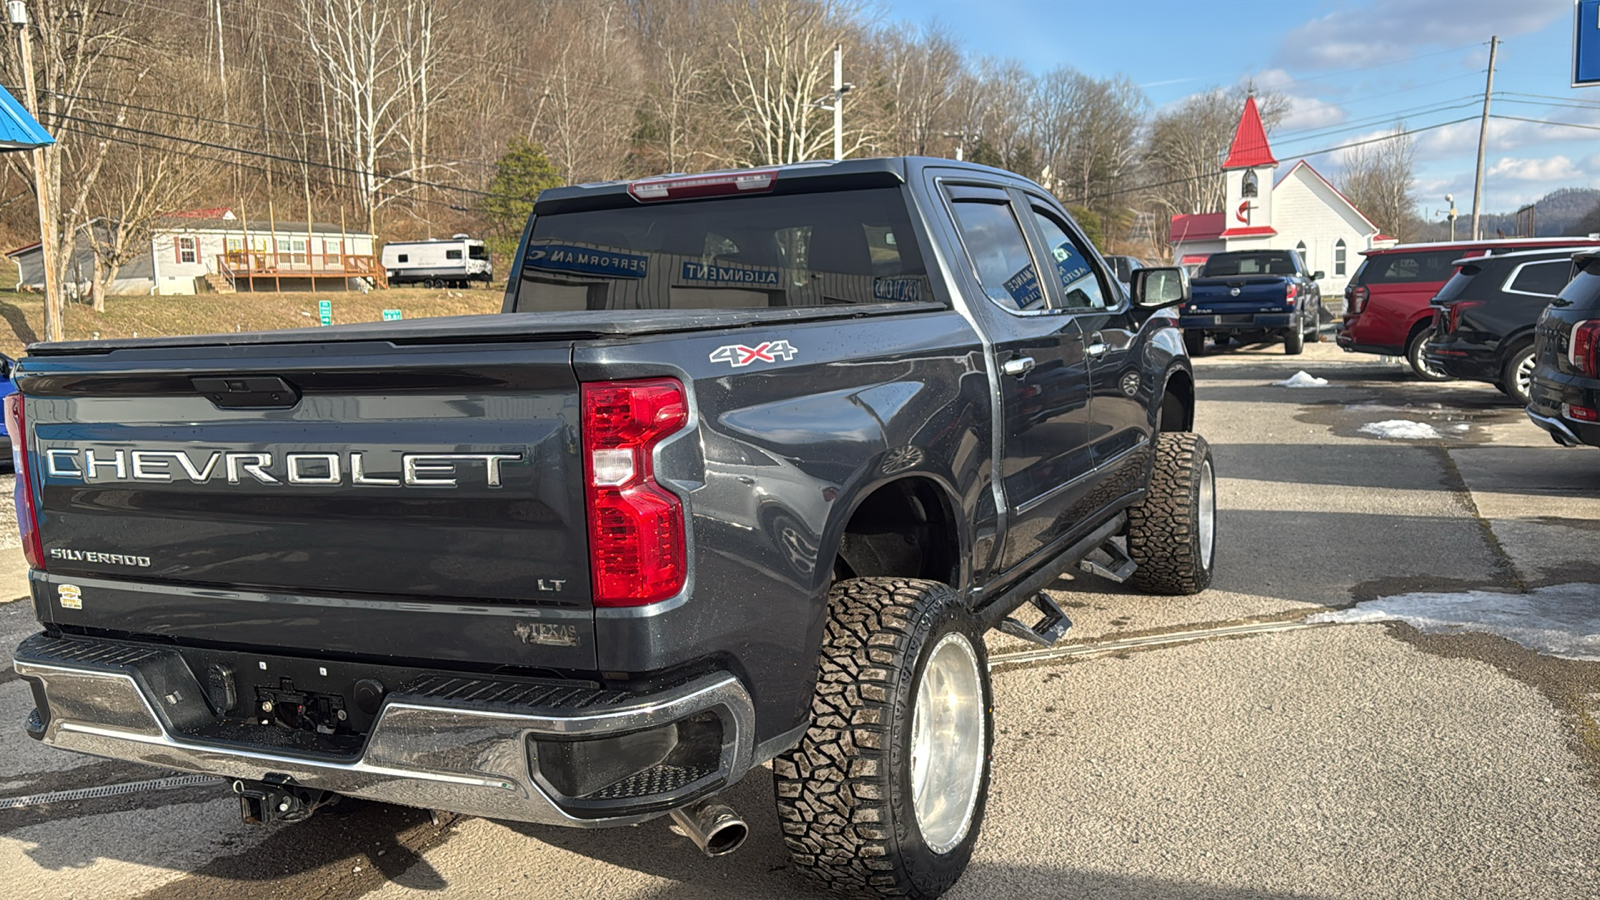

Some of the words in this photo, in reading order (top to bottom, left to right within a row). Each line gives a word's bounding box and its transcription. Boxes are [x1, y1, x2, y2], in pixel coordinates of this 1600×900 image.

[46, 448, 523, 487] CHEVROLET
[50, 548, 151, 567] SILVERADO
[537, 579, 567, 592] LT
[529, 622, 576, 639] TEXAS
